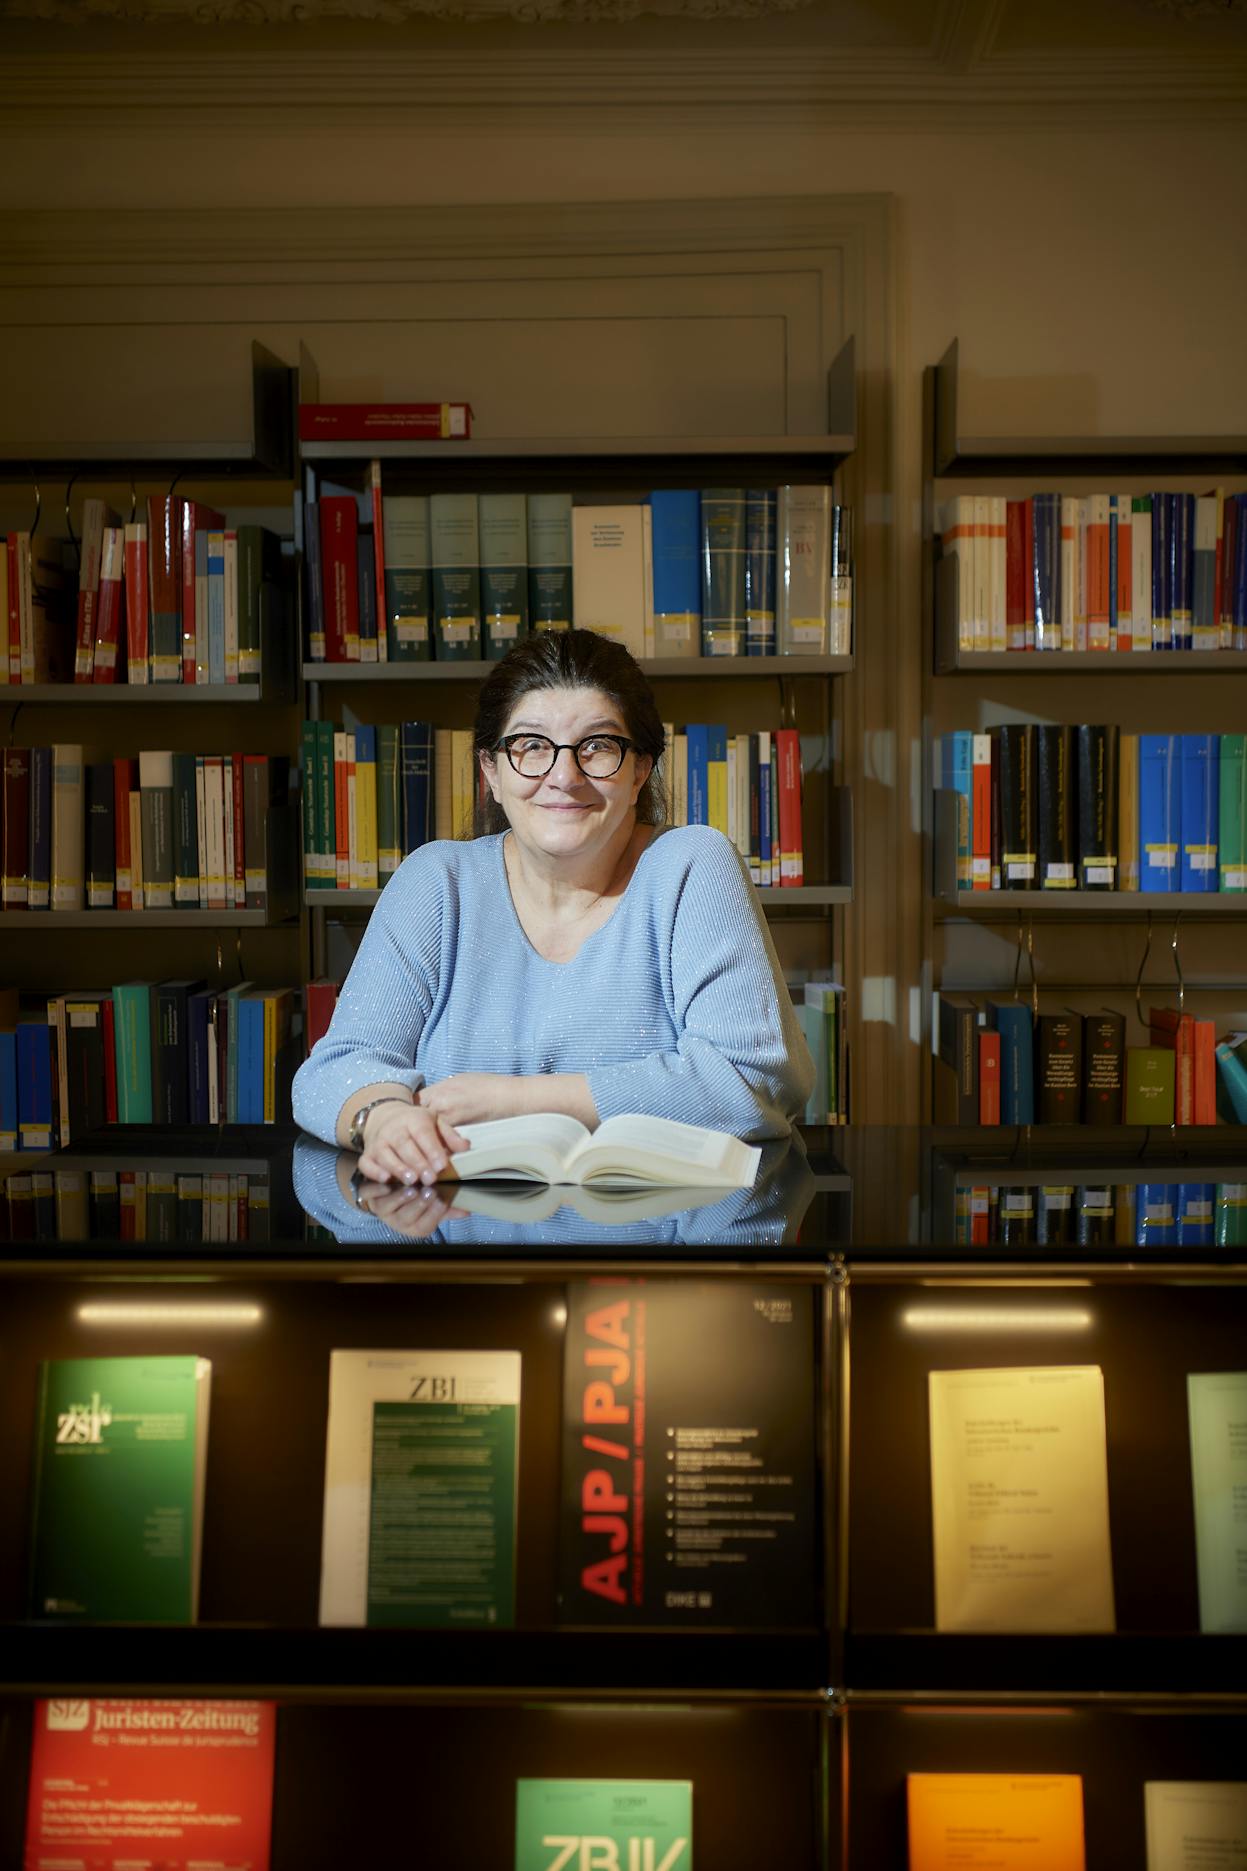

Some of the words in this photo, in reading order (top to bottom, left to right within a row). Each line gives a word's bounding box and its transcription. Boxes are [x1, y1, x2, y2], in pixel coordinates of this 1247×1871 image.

[583, 1300, 631, 1425] PJA
[582, 1434, 630, 1461] /
[581, 1469, 629, 1605] AJP
[94, 1708, 259, 1736] Juristen-Zeitung
